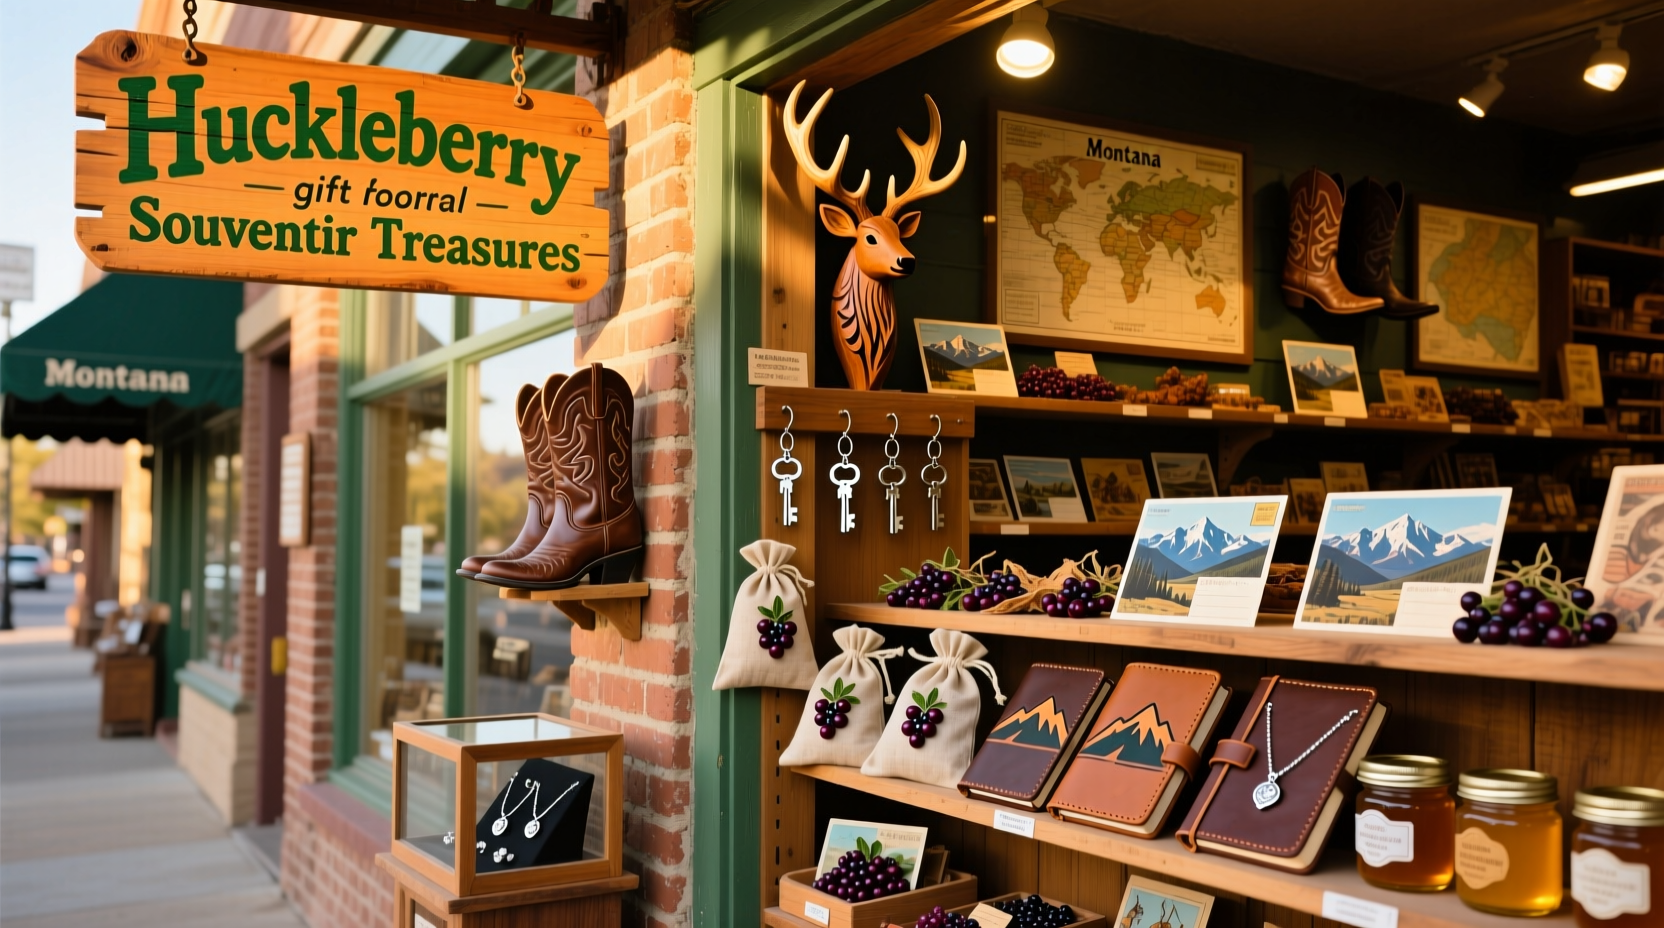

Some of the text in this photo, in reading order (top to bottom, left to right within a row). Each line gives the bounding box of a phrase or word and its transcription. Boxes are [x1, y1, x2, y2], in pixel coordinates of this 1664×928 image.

[118, 74, 580, 214] Huckleberry
[1086, 137, 1161, 168] Montana
[293, 175, 351, 210] gift
[130, 196, 580, 271] Souventir Treasures
